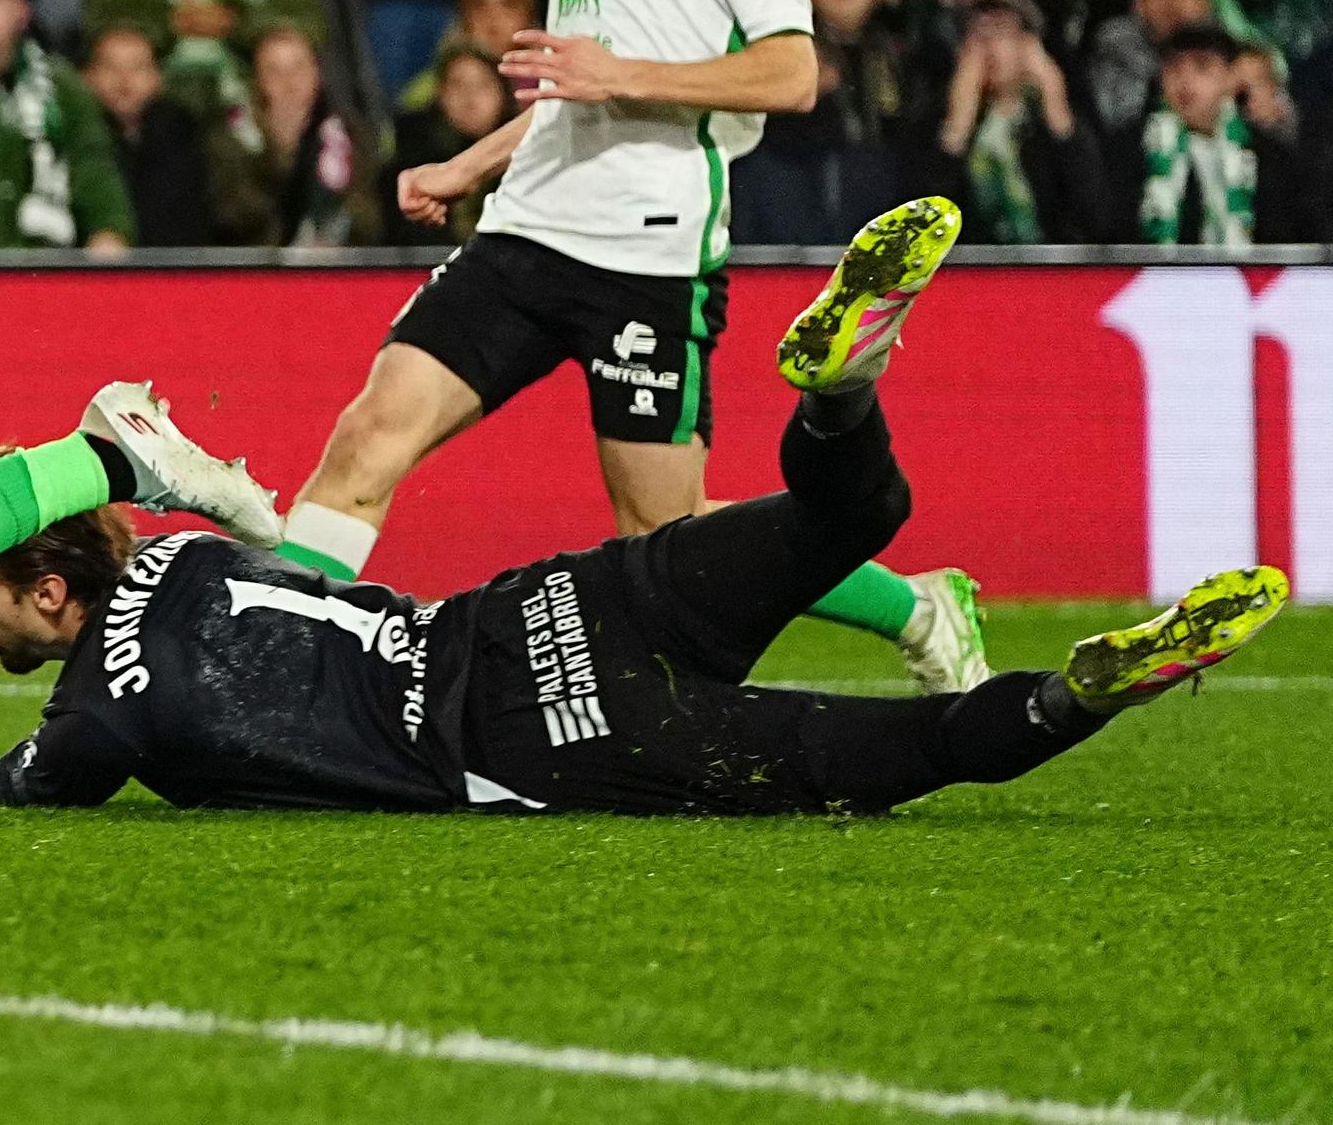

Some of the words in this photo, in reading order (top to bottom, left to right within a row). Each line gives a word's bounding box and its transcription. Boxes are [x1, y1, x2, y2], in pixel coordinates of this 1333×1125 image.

[104, 585, 153, 699] JOKIN
[224, 577, 387, 653] 1
[521, 587, 550, 631] DEL
[544, 570, 598, 696] CANTÁBRICO
[527, 630, 565, 703] PALETS
